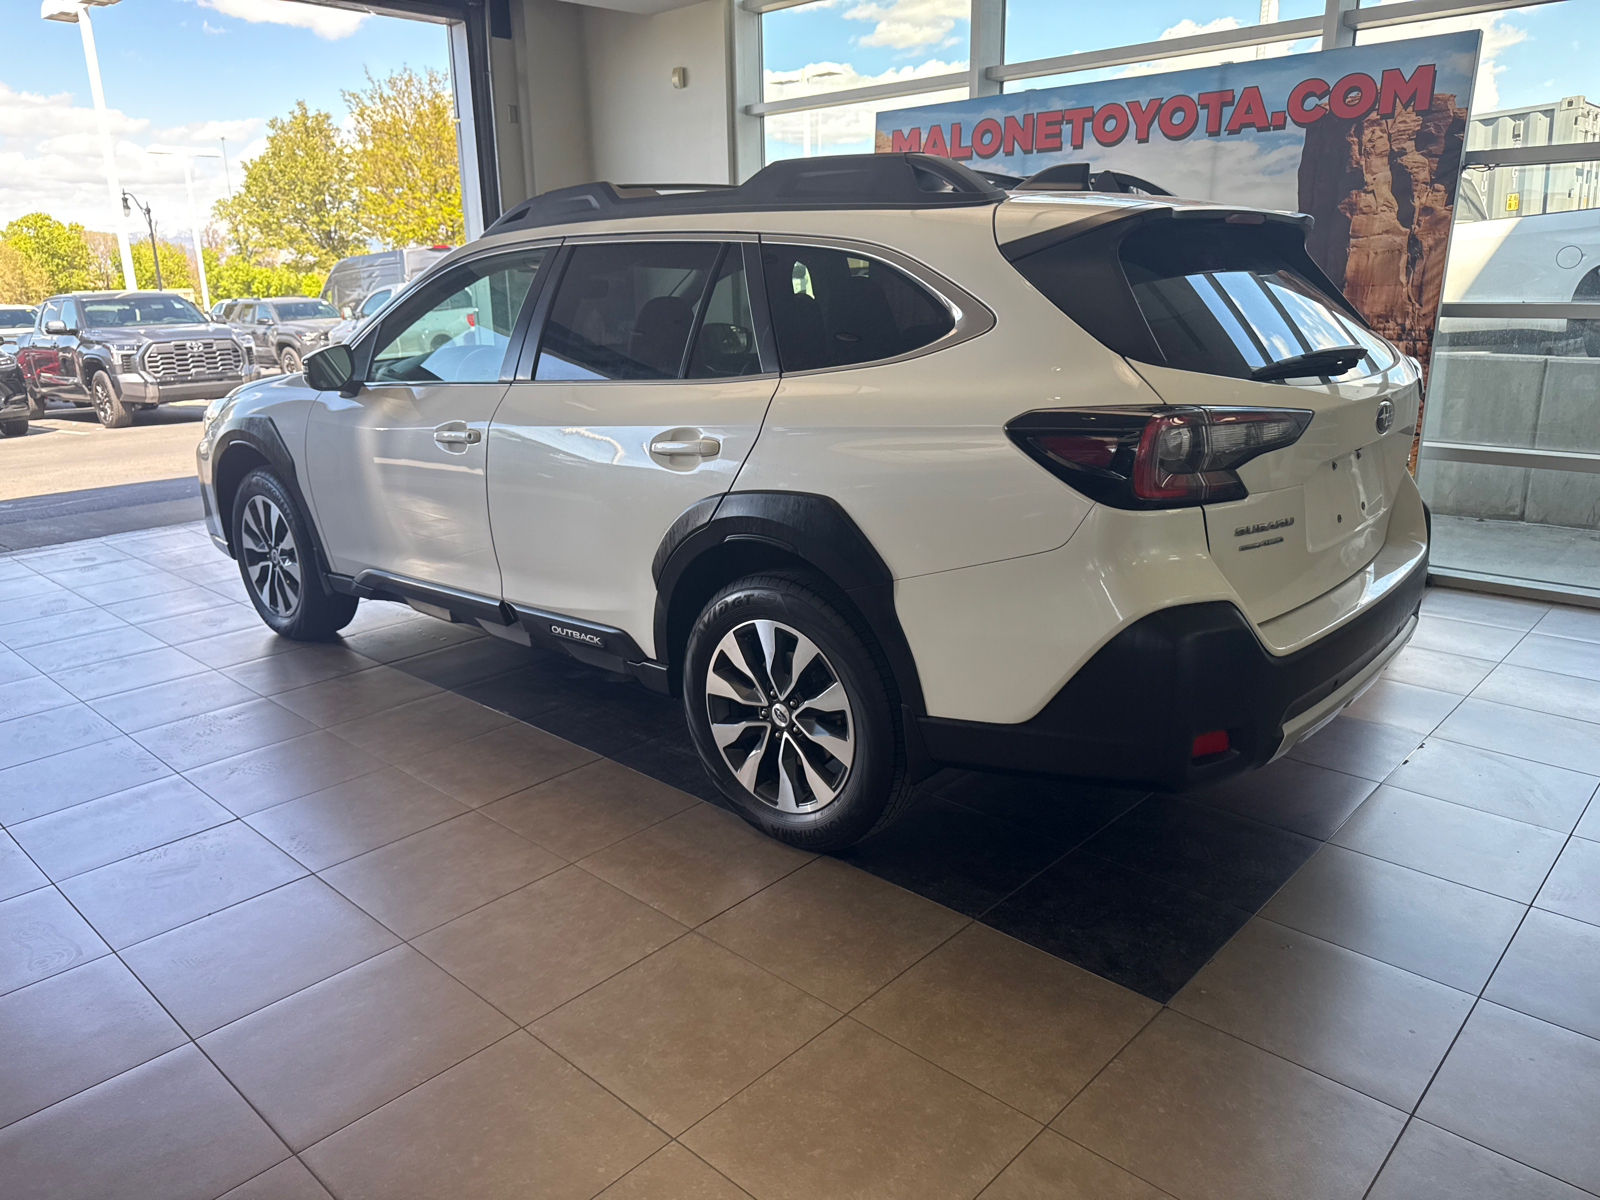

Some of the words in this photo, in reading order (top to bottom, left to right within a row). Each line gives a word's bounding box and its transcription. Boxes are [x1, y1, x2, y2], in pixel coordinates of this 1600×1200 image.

[891, 63, 1437, 161] MALONETOYOTA.COM
[1234, 516, 1294, 536] SUBARU
[731, 594, 755, 607] GT
[551, 625, 603, 646] OUTBACK
